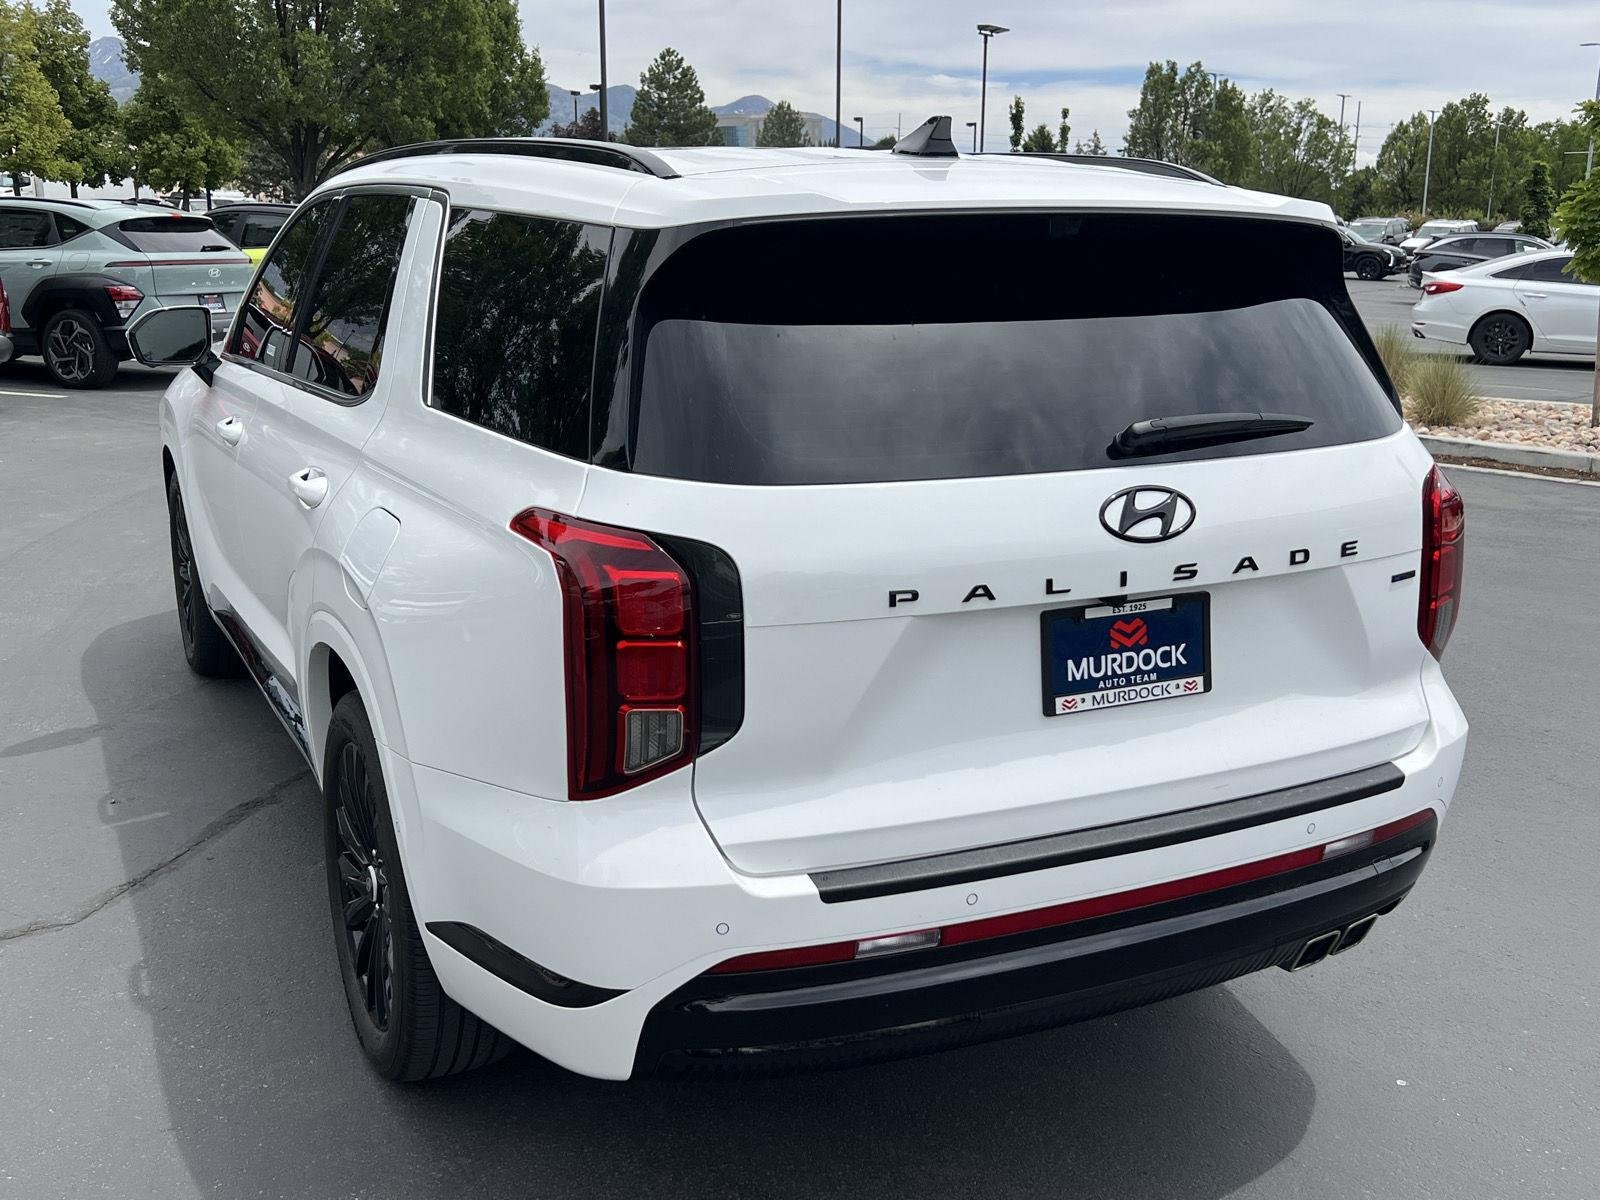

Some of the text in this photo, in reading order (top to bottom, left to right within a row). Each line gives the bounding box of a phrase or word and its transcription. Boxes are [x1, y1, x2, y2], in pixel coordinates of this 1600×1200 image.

[888, 539, 1360, 608] PALISADE
[1129, 602, 1147, 612] 1925
[1066, 643, 1187, 681] MURDOCK
[1098, 673, 1157, 688] AUTO TEAM
[1092, 683, 1172, 707] MURDOCK
